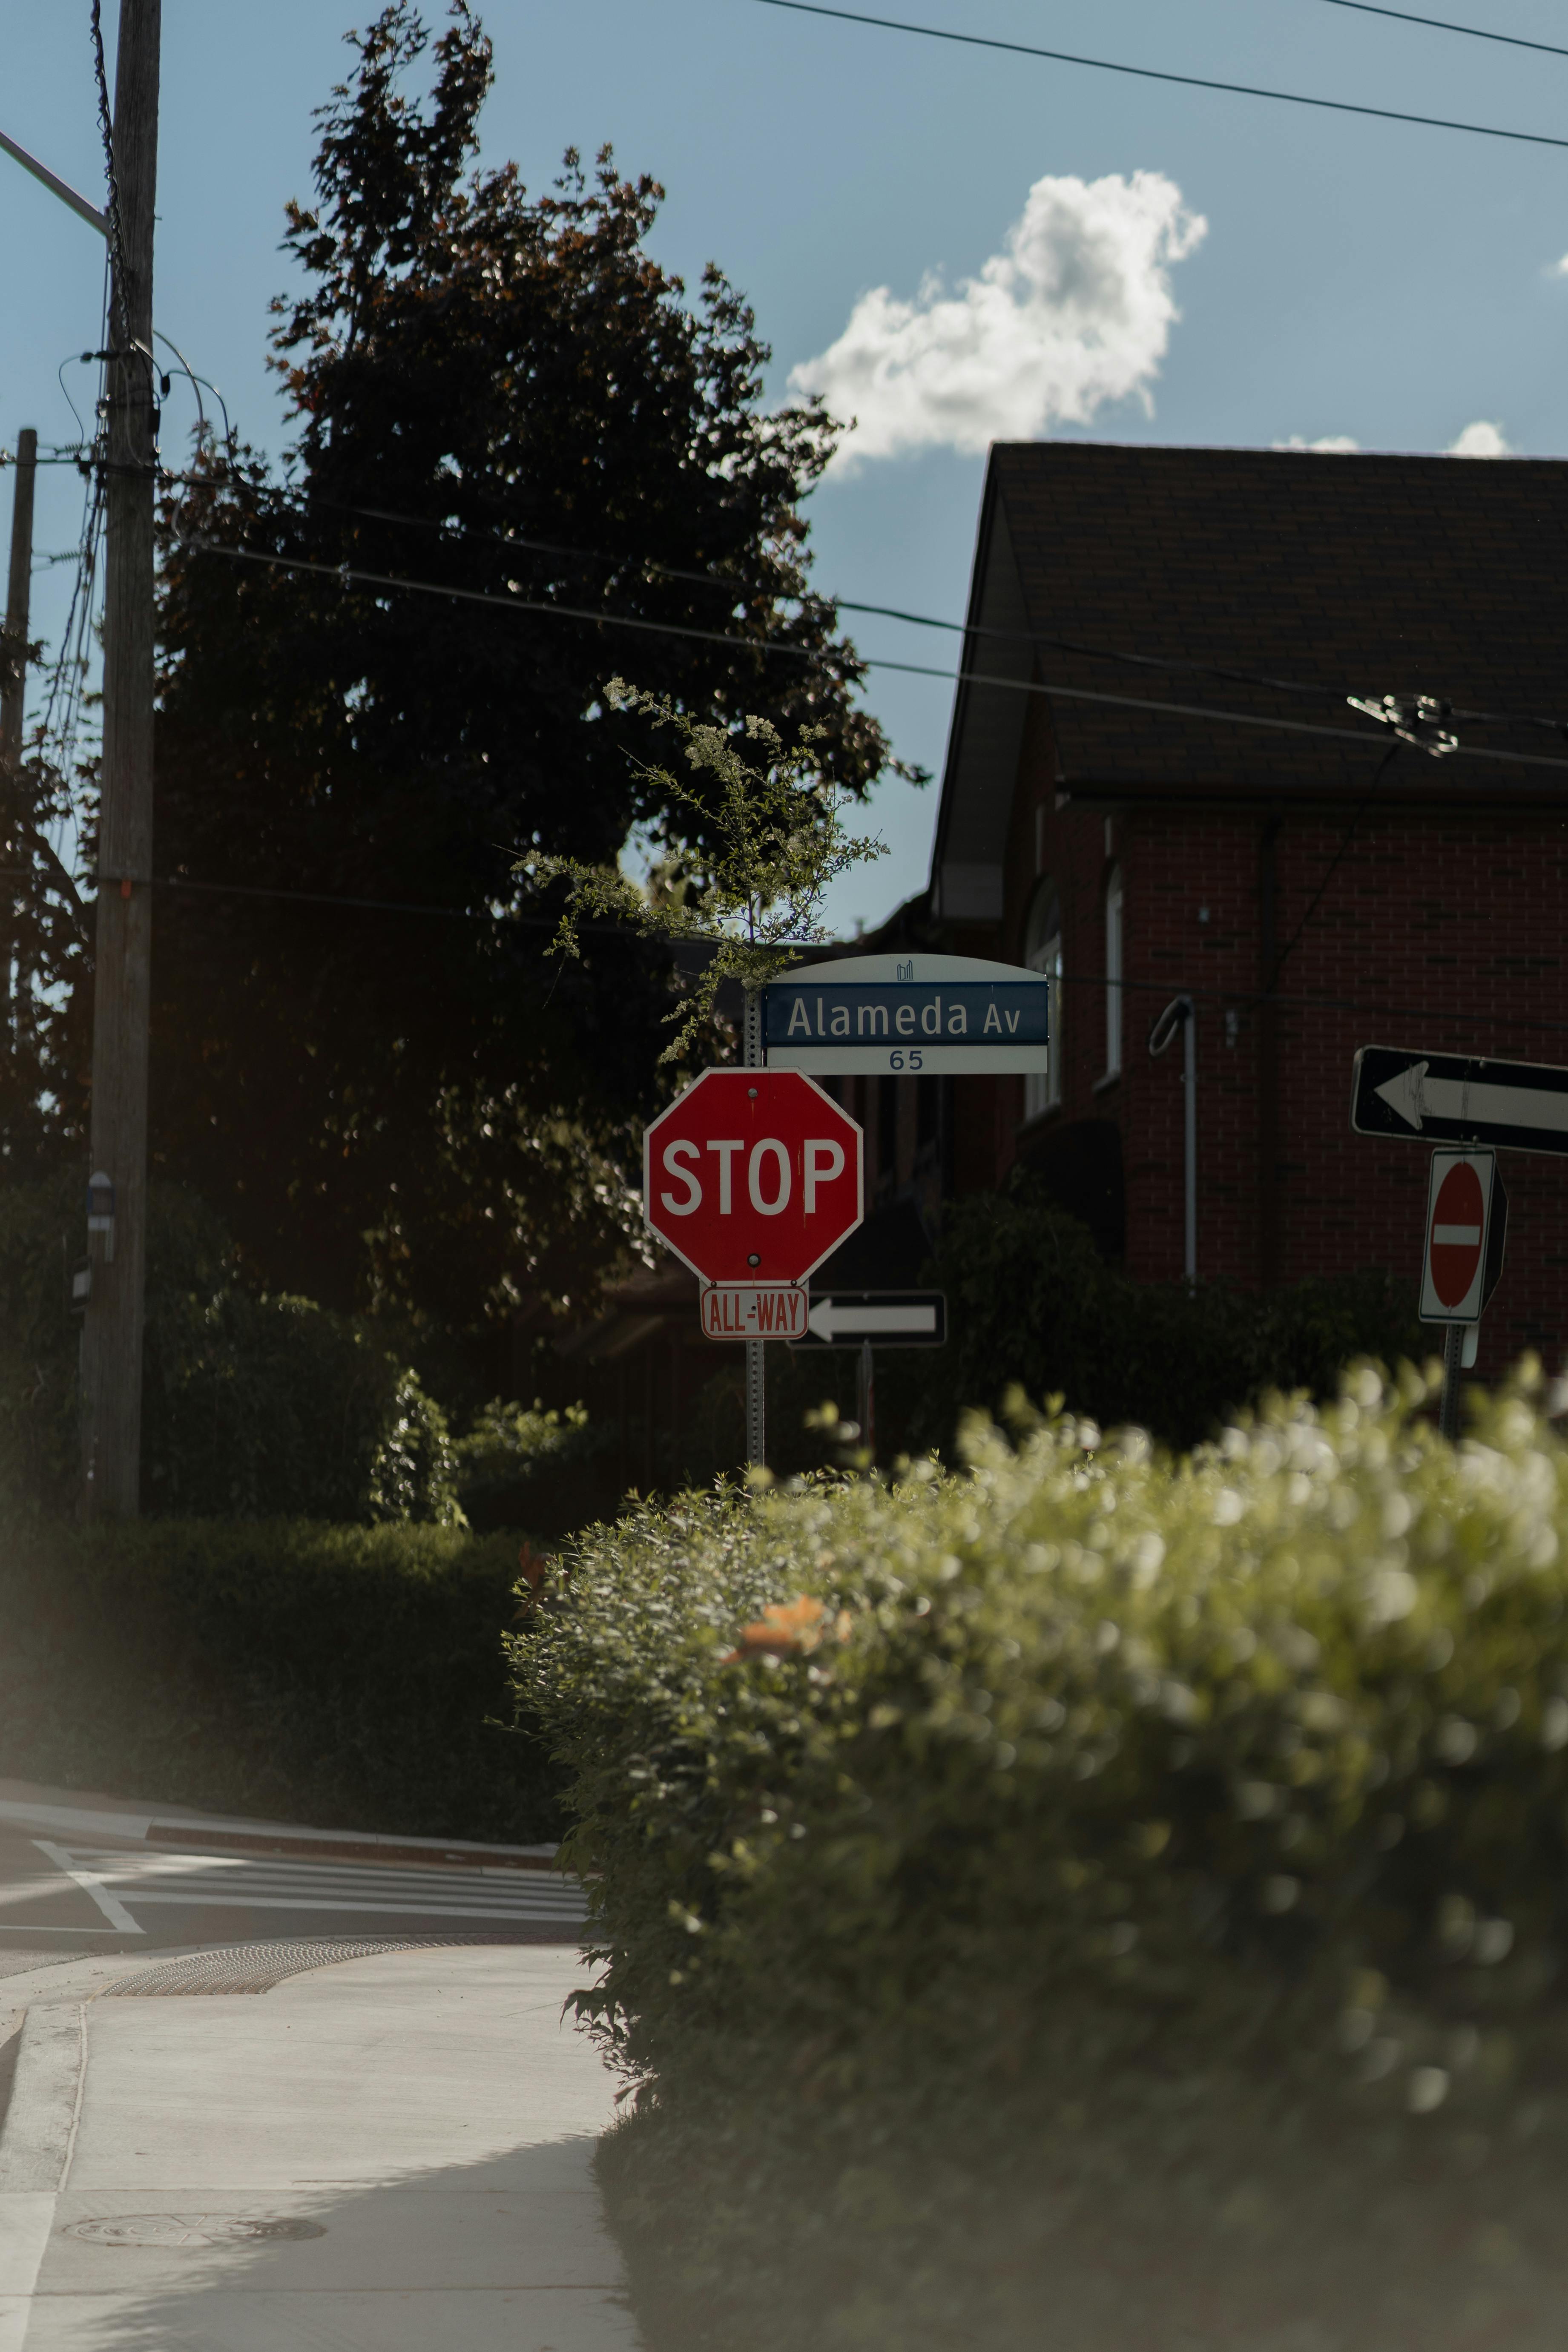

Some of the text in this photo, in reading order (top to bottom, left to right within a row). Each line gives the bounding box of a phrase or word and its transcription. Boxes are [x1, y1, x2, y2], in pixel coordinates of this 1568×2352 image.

[787, 997, 1020, 1036] Alameda Av
[890, 1050, 923, 1070] 65
[661, 1138, 845, 1216] STOP
[710, 1294, 799, 1331] ALL-WAY
